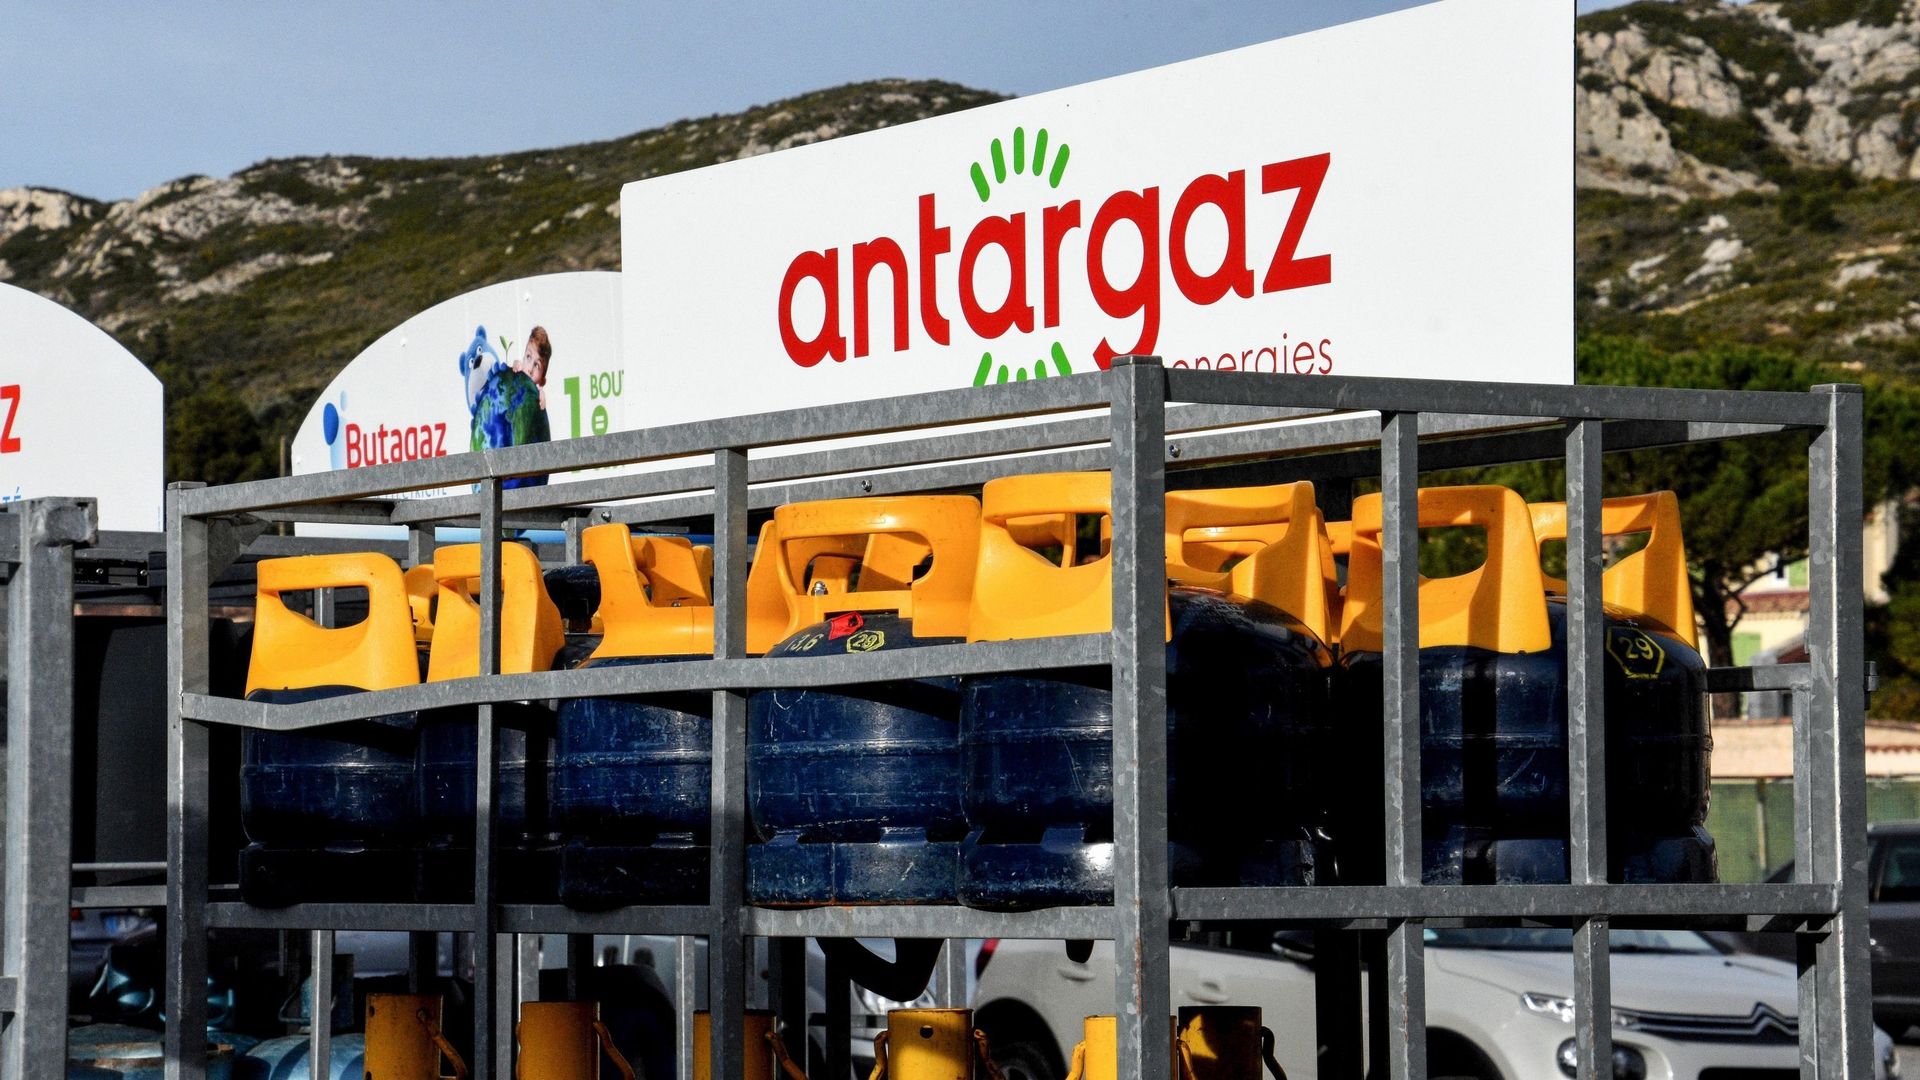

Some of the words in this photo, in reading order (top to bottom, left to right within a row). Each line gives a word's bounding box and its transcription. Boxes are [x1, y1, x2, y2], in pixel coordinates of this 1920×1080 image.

[778, 152, 1332, 370] antargaz
[590, 369, 624, 400] BOU
[345, 422, 447, 470] Butagaz
[852, 633, 879, 649] 29
[1617, 636, 1654, 660] 29
